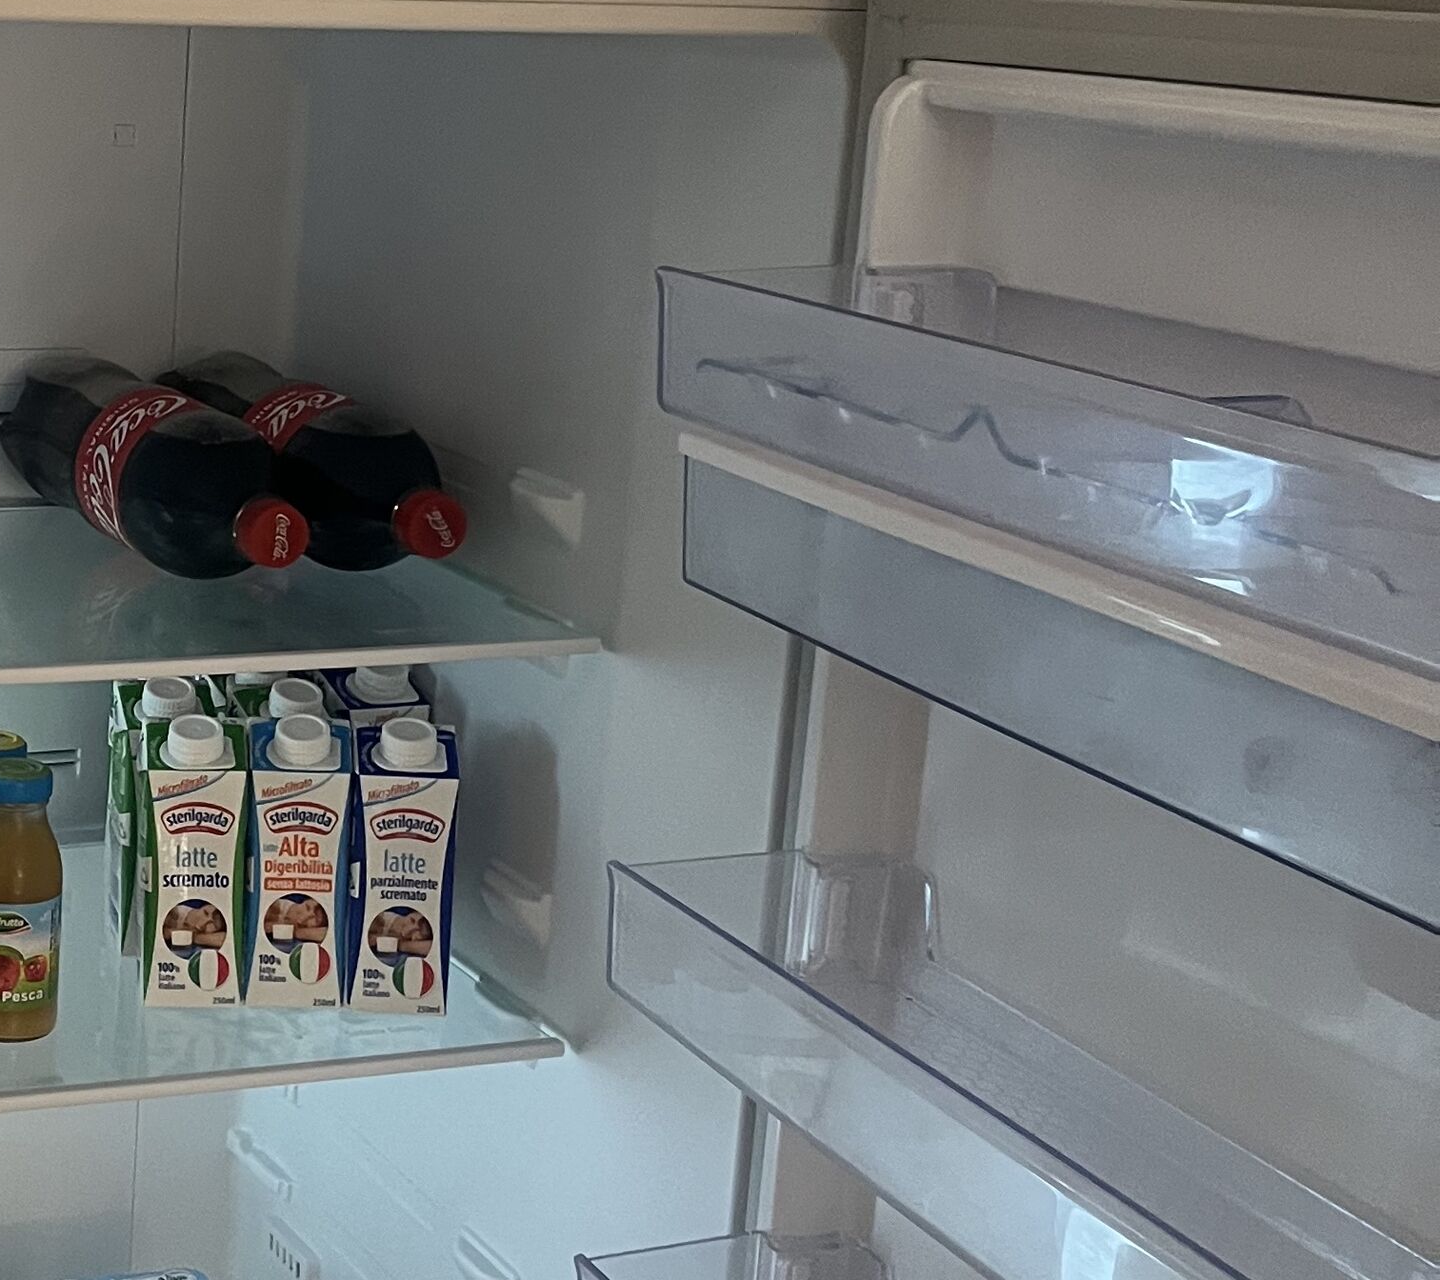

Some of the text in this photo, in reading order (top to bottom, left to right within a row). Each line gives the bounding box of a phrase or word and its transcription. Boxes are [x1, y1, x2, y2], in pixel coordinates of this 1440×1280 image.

[166, 808, 229, 827] sterilgarda
[269, 807, 332, 827] sterilgarda
[376, 814, 439, 835] sterilgarda
[278, 834, 320, 857] Alta
[176, 845, 218, 868] latte
[384, 849, 426, 874] latte
[163, 872, 229, 888] scremato
[370, 875, 438, 890] parzialmente
[380, 889, 427, 901] scremato
[2, 989, 44, 1003] Pesca
